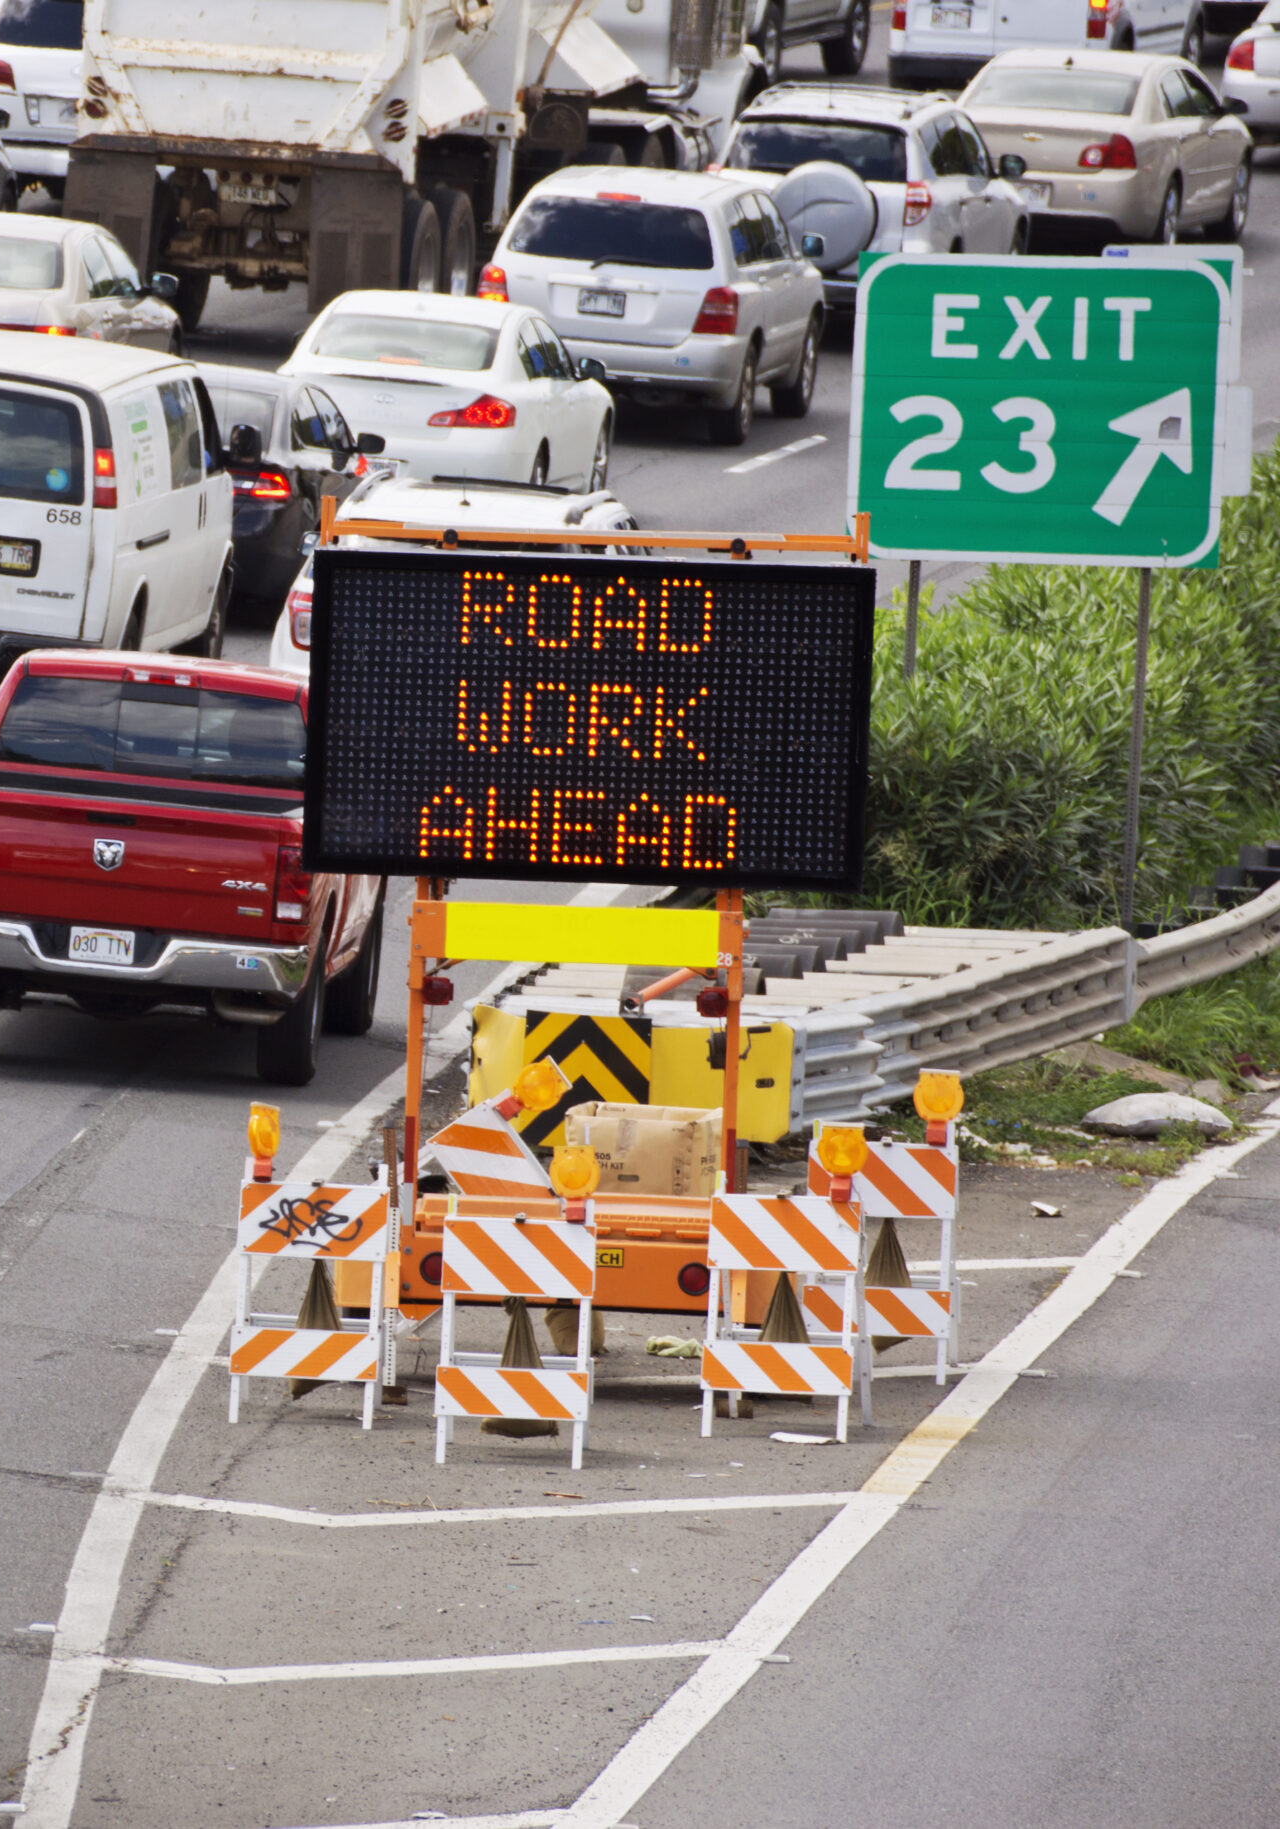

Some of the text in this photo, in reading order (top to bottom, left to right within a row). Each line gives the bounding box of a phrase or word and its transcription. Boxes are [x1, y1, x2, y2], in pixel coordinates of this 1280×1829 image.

[931, 293, 1151, 361] EXIT
[884, 395, 1056, 494] 23
[46, 508, 82, 526] 658
[16, 587, 76, 600] CHEVROLET
[461, 570, 713, 651] ROAD
[457, 679, 708, 761] WORK
[419, 785, 737, 868] AHEAD
[73, 935, 132, 956] 030 TTV
[716, 952, 733, 967] 28
[610, 1161, 624, 1170] KIT
